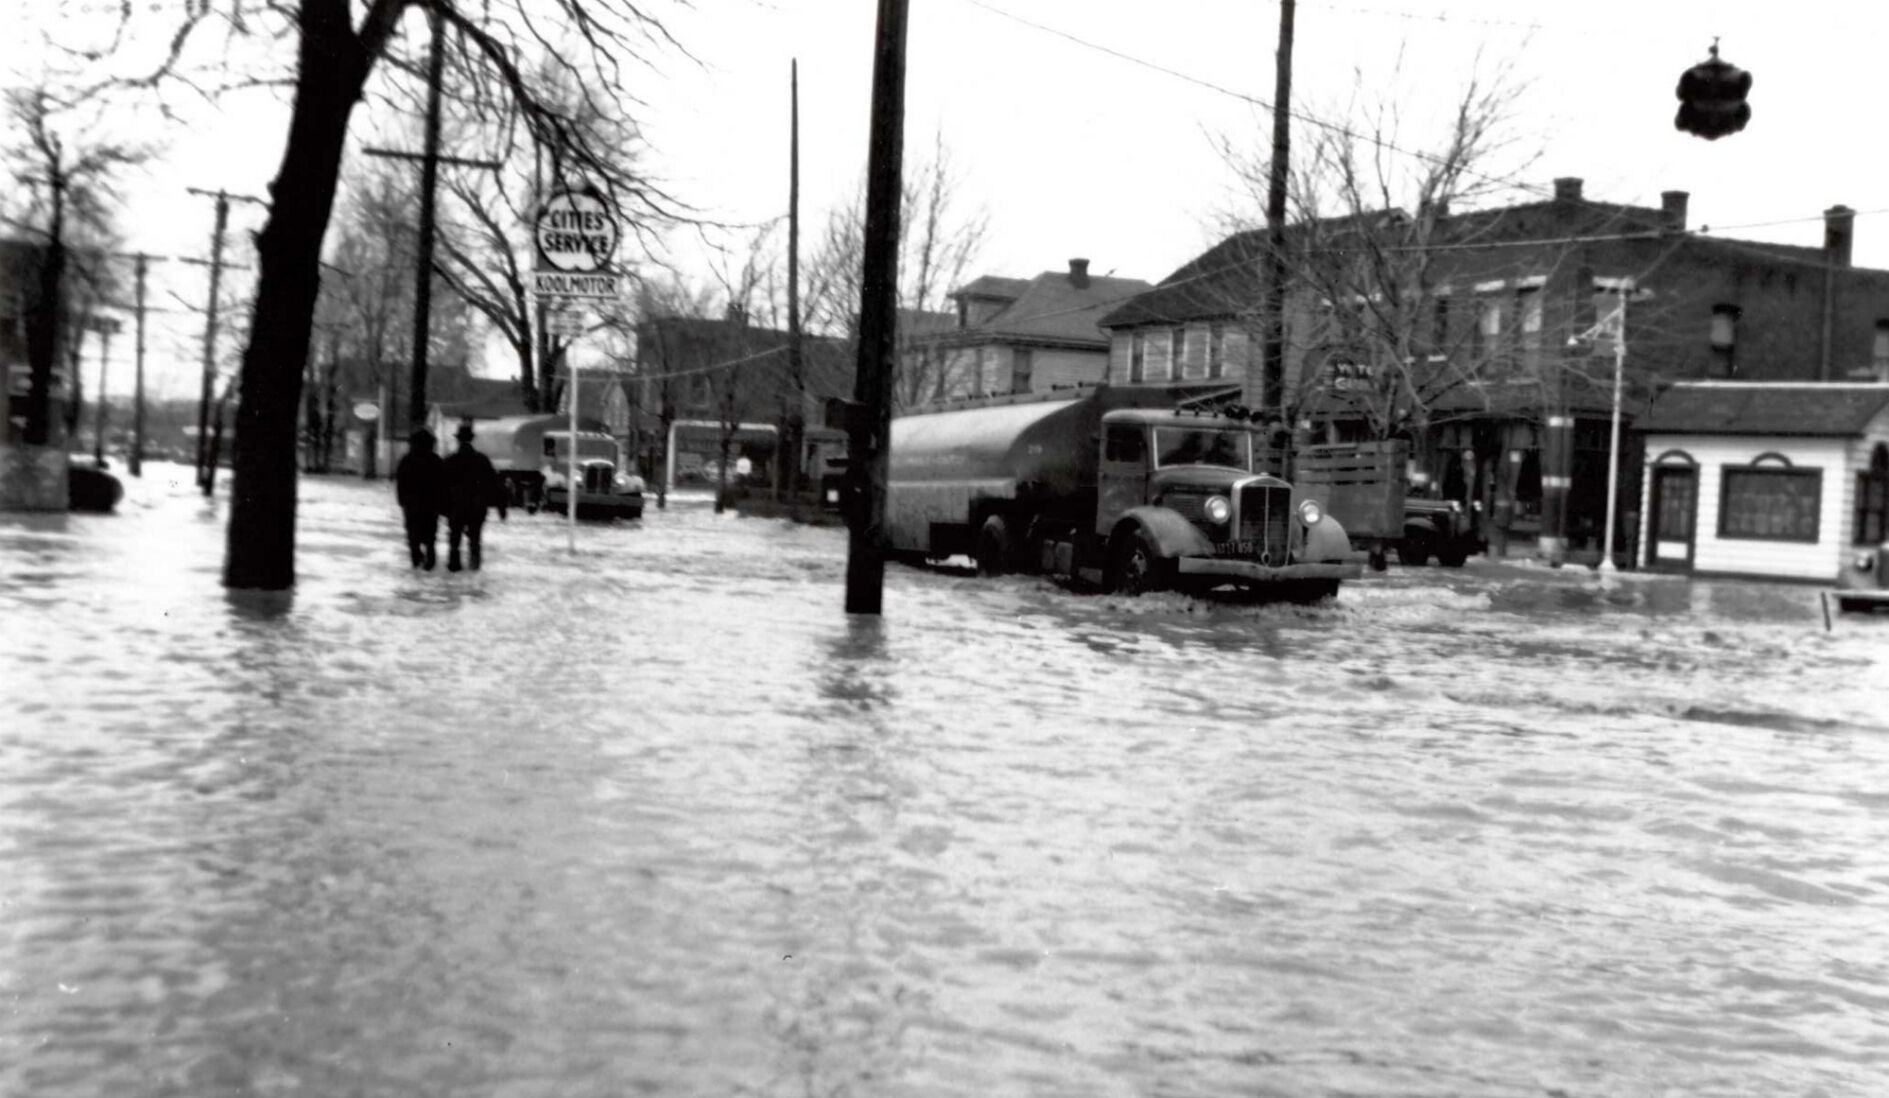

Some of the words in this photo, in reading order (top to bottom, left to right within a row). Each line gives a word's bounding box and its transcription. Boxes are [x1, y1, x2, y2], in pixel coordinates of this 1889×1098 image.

[551, 209, 605, 231] CITIES
[544, 232, 609, 255] SERVICE
[536, 275, 616, 294] KOOLMOTOR
